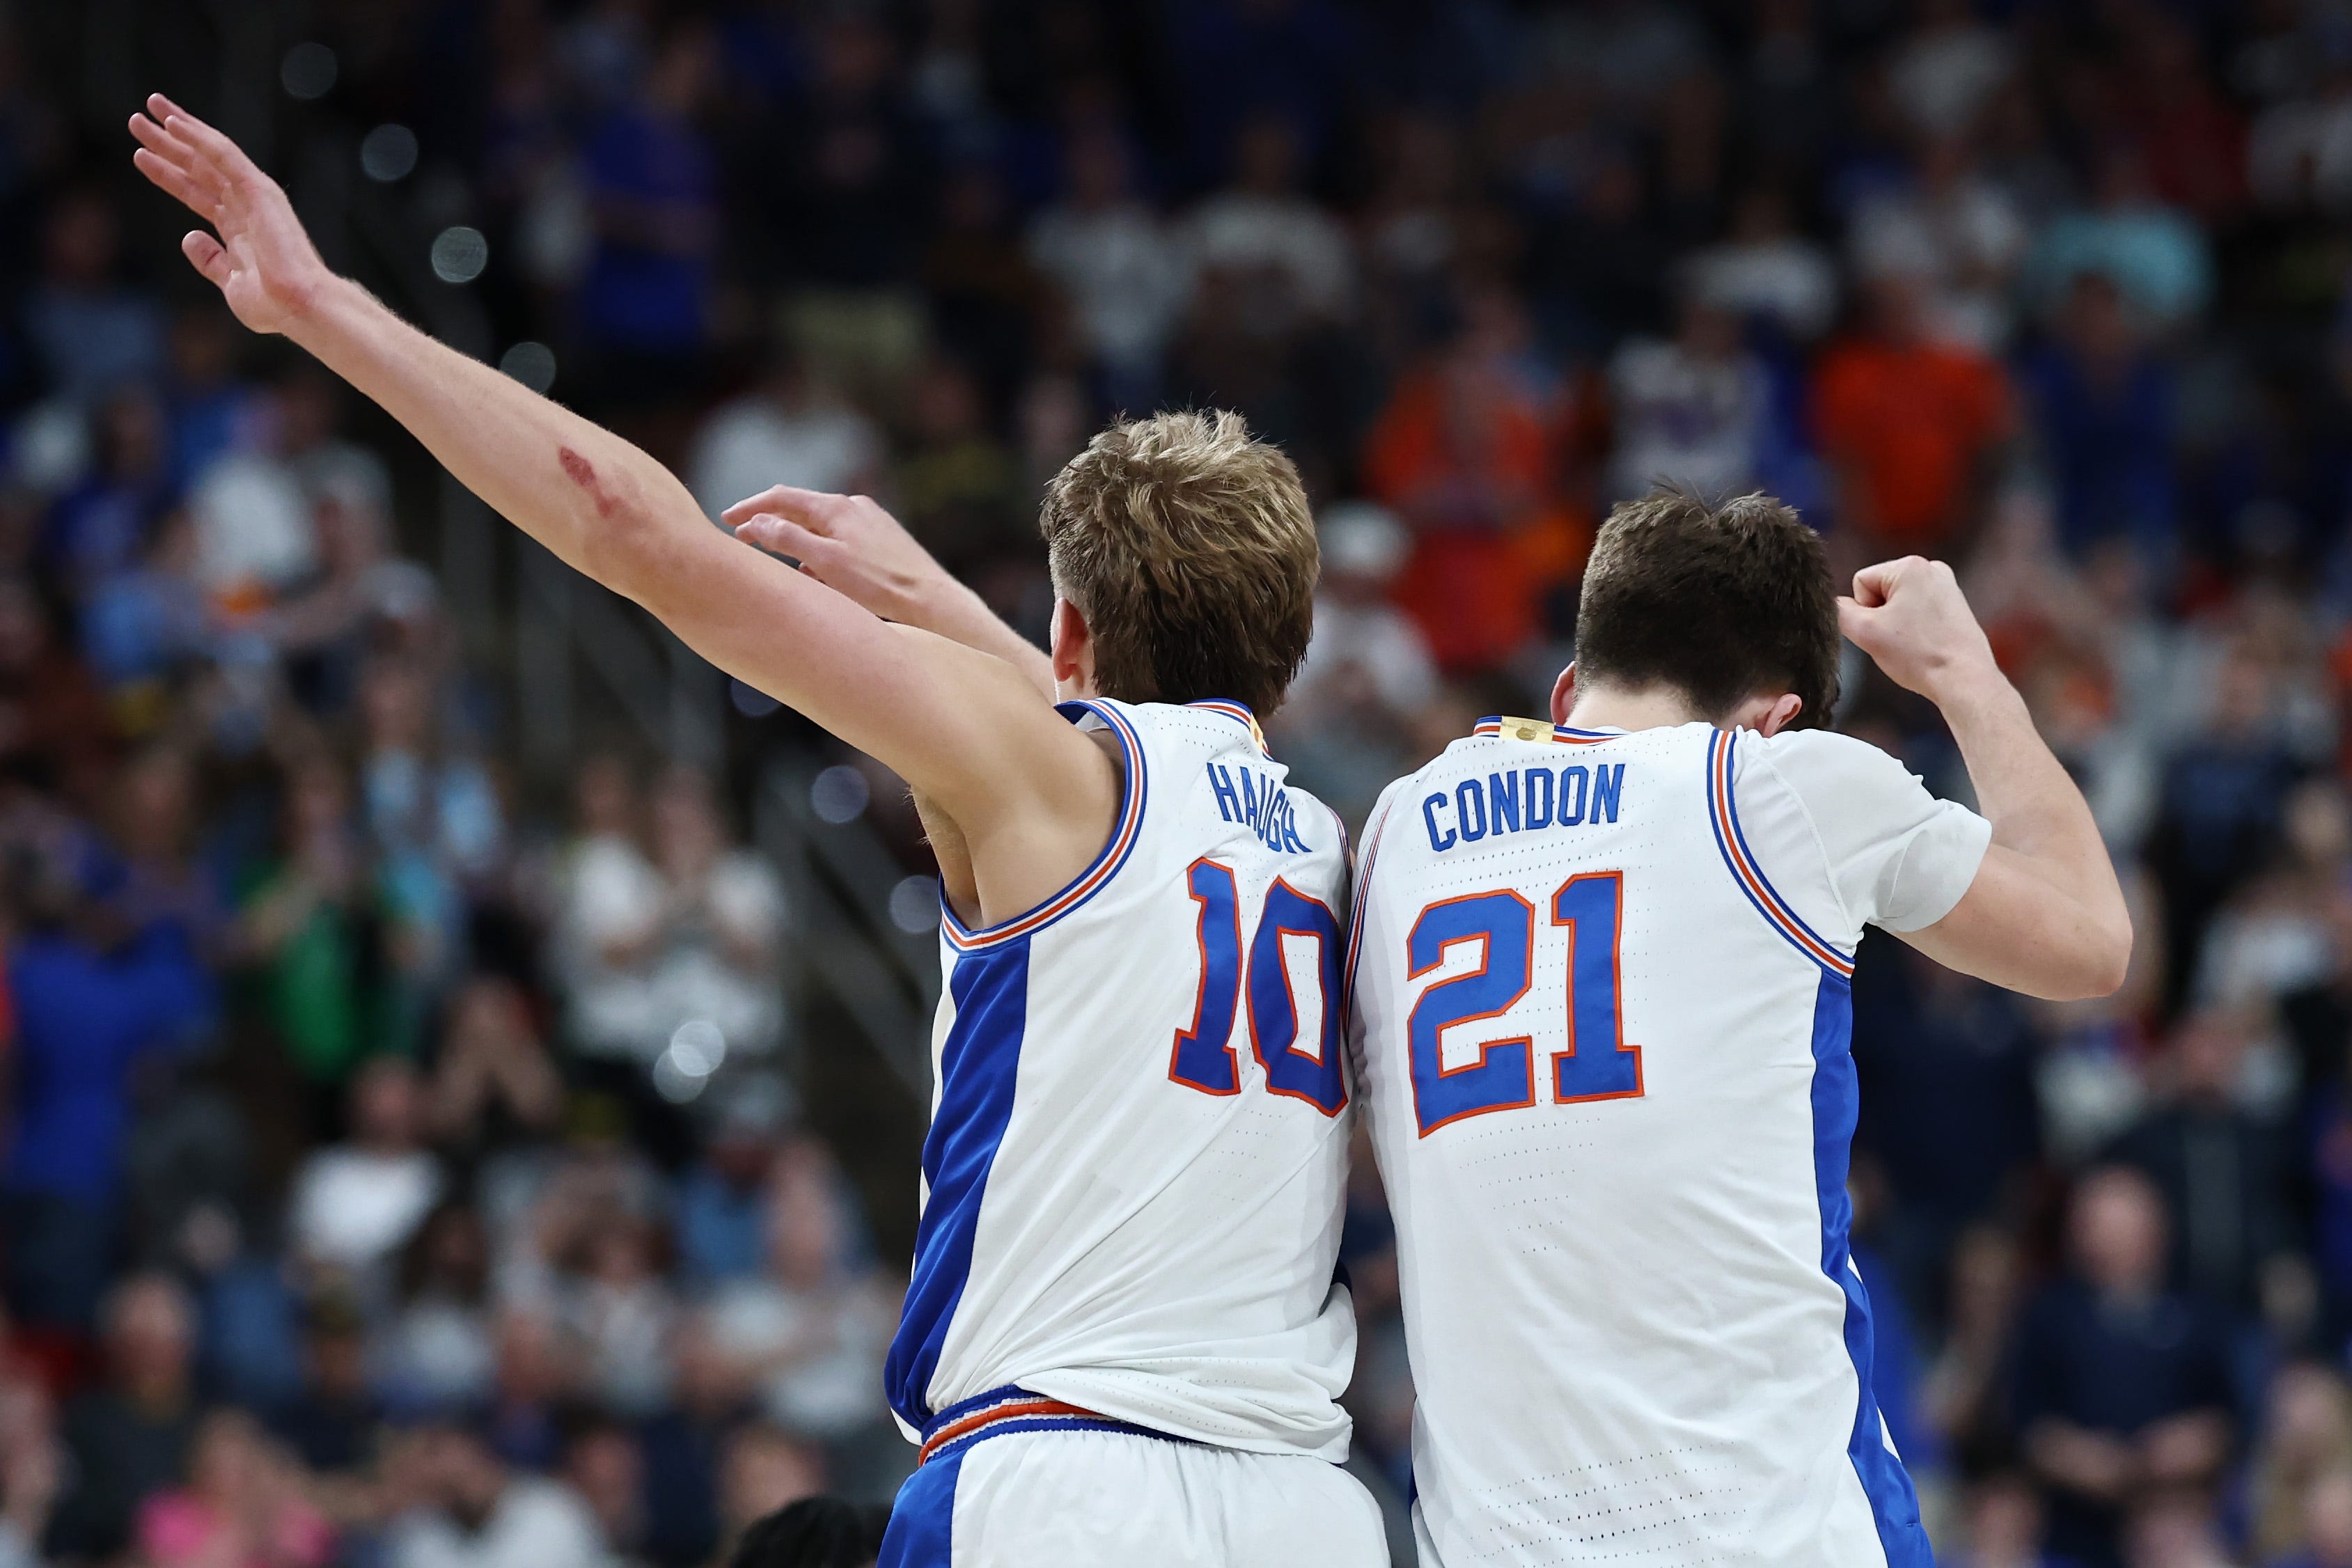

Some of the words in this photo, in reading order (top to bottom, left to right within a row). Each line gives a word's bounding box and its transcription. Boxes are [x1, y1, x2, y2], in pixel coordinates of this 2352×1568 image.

[1206, 762, 1312, 854] HAUGH
[1422, 763, 1626, 852] CONDON
[1168, 856, 1348, 1118] 10
[1406, 870, 1645, 1138] 21
